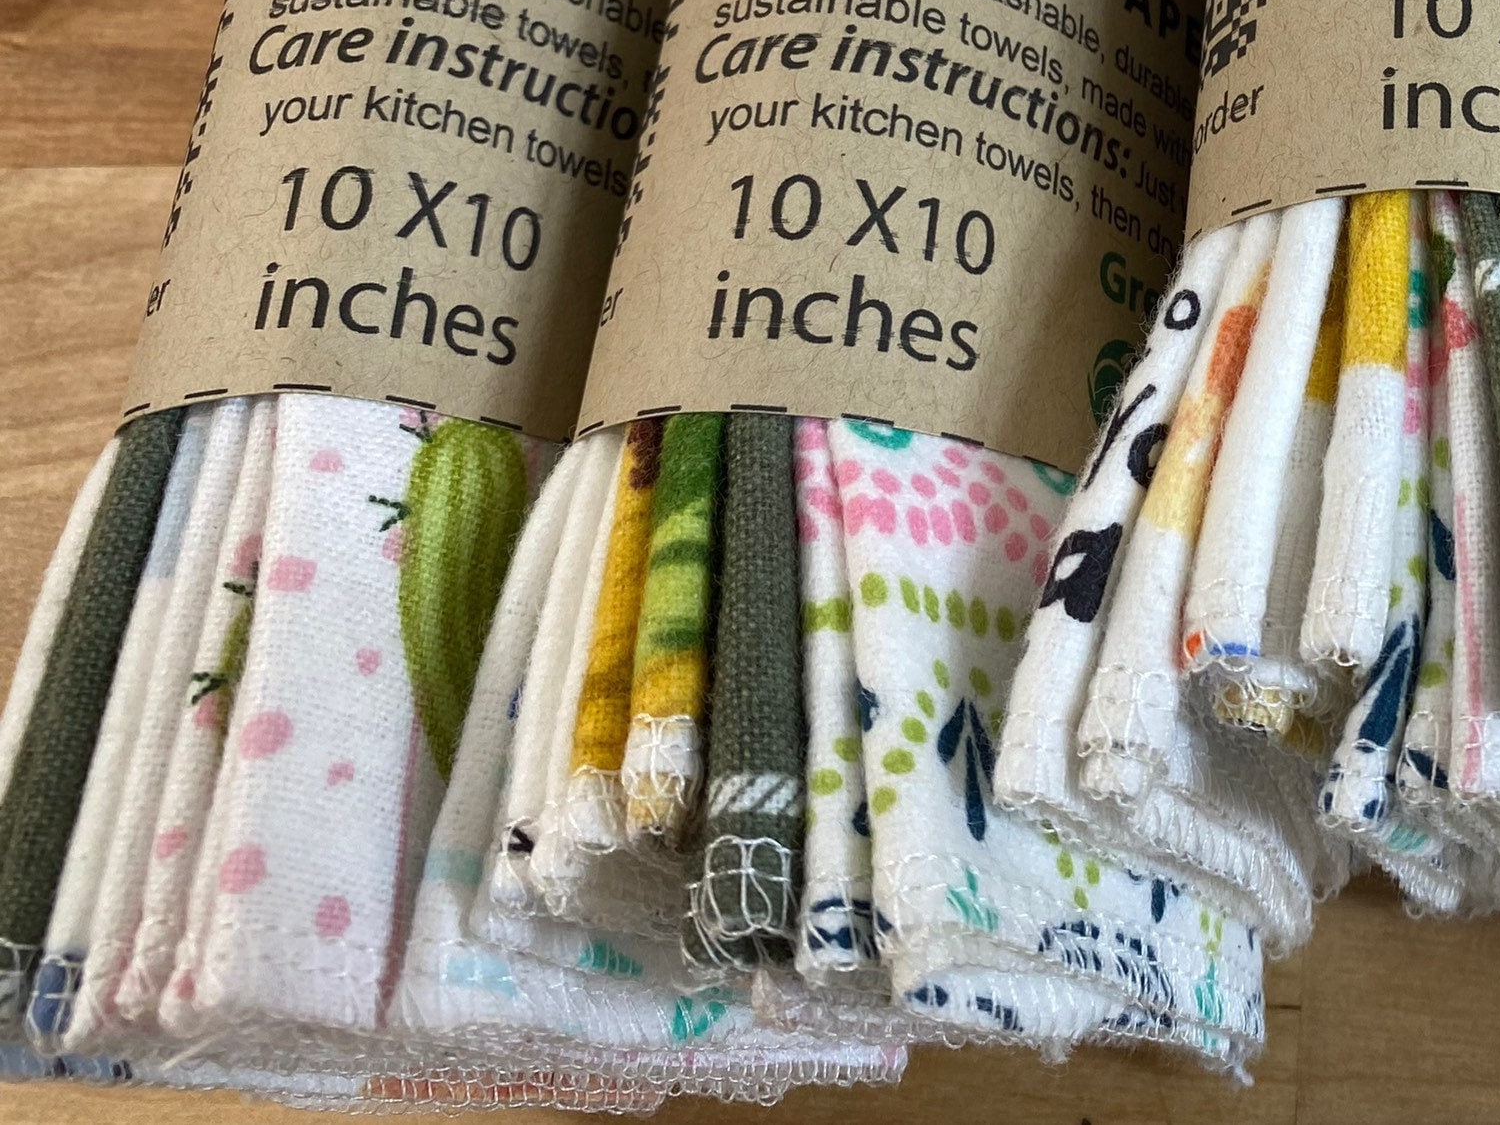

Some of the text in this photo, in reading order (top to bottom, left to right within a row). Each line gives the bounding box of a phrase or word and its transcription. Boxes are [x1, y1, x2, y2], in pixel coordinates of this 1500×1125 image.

[248, 24, 374, 76] Care
[518, 8, 629, 90] towels,
[959, 12, 1069, 96] towels,
[1081, 77, 1147, 138] made
[259, 88, 352, 137] your
[364, 86, 514, 155] kitchen
[695, 29, 818, 83] Care
[830, 24, 1132, 179] instructions:
[281, 164, 541, 273] 10 X10
[703, 98, 800, 145] your
[811, 92, 964, 157] kitchen
[975, 130, 1080, 213] towels,
[1090, 184, 1142, 243] then
[728, 173, 997, 277] 10 X10
[254, 262, 520, 366] inches
[706, 269, 981, 373] inches
